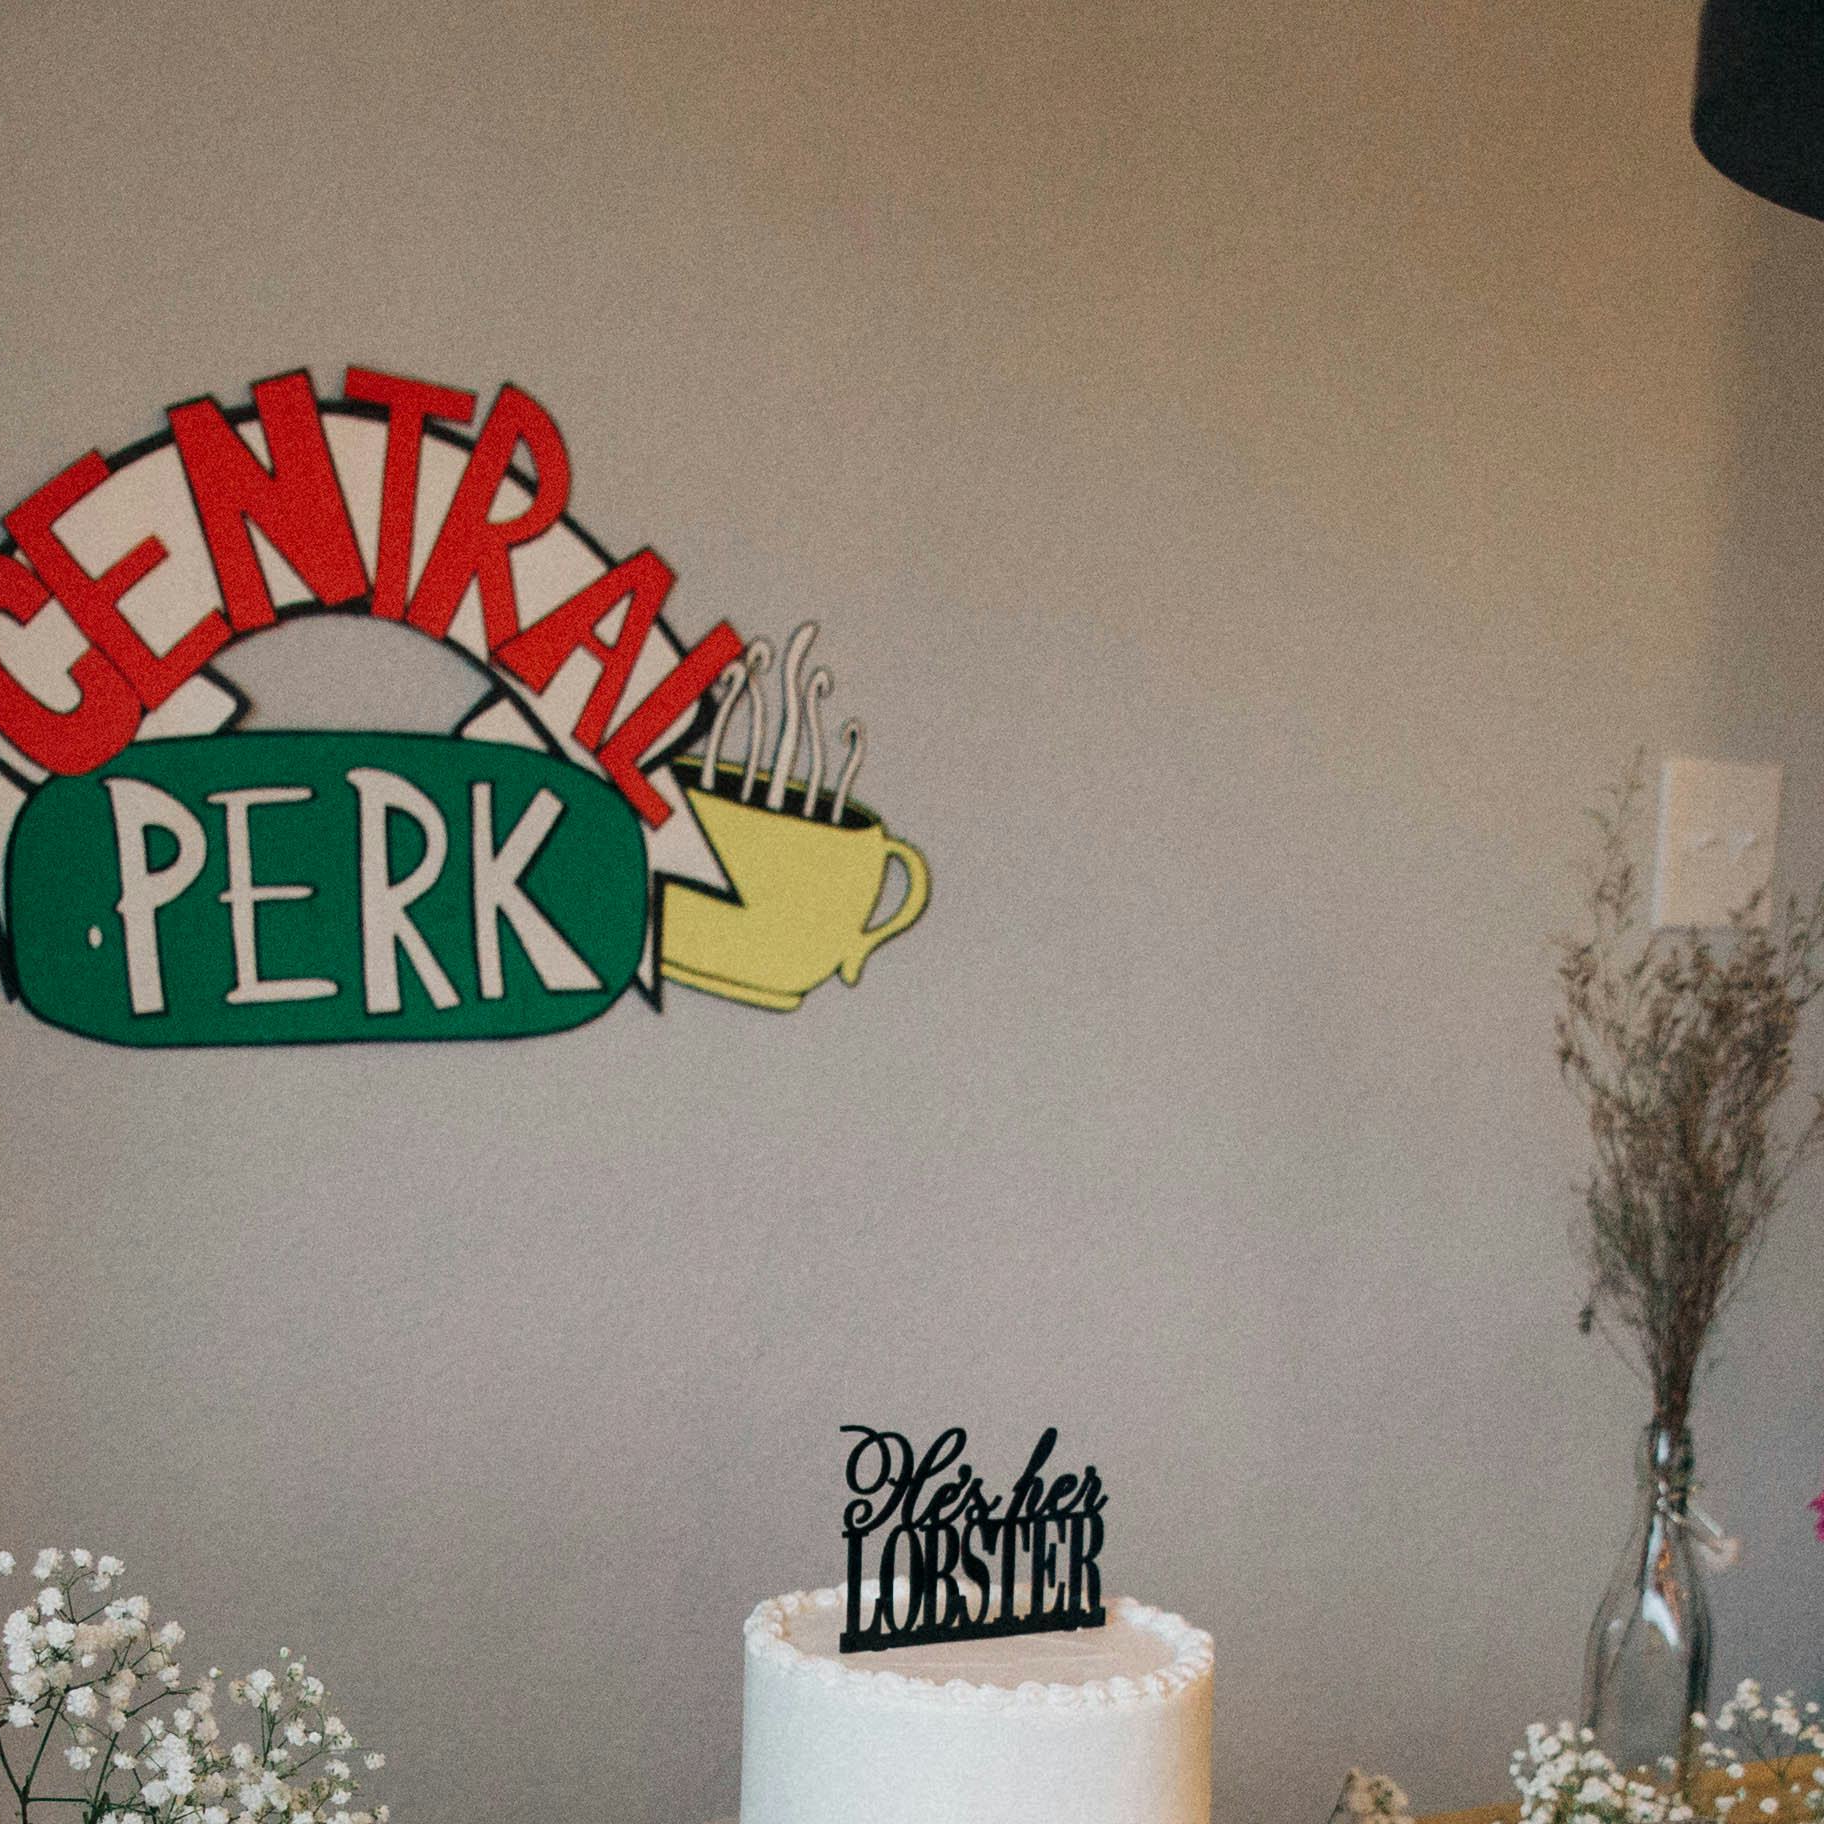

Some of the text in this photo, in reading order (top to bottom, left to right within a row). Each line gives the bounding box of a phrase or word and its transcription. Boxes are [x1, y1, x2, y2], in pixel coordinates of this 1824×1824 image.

[105, 767, 603, 1016] PERK
[1010, 1427, 1109, 1523] her
[840, 1512, 1107, 1651] LOBSTER
